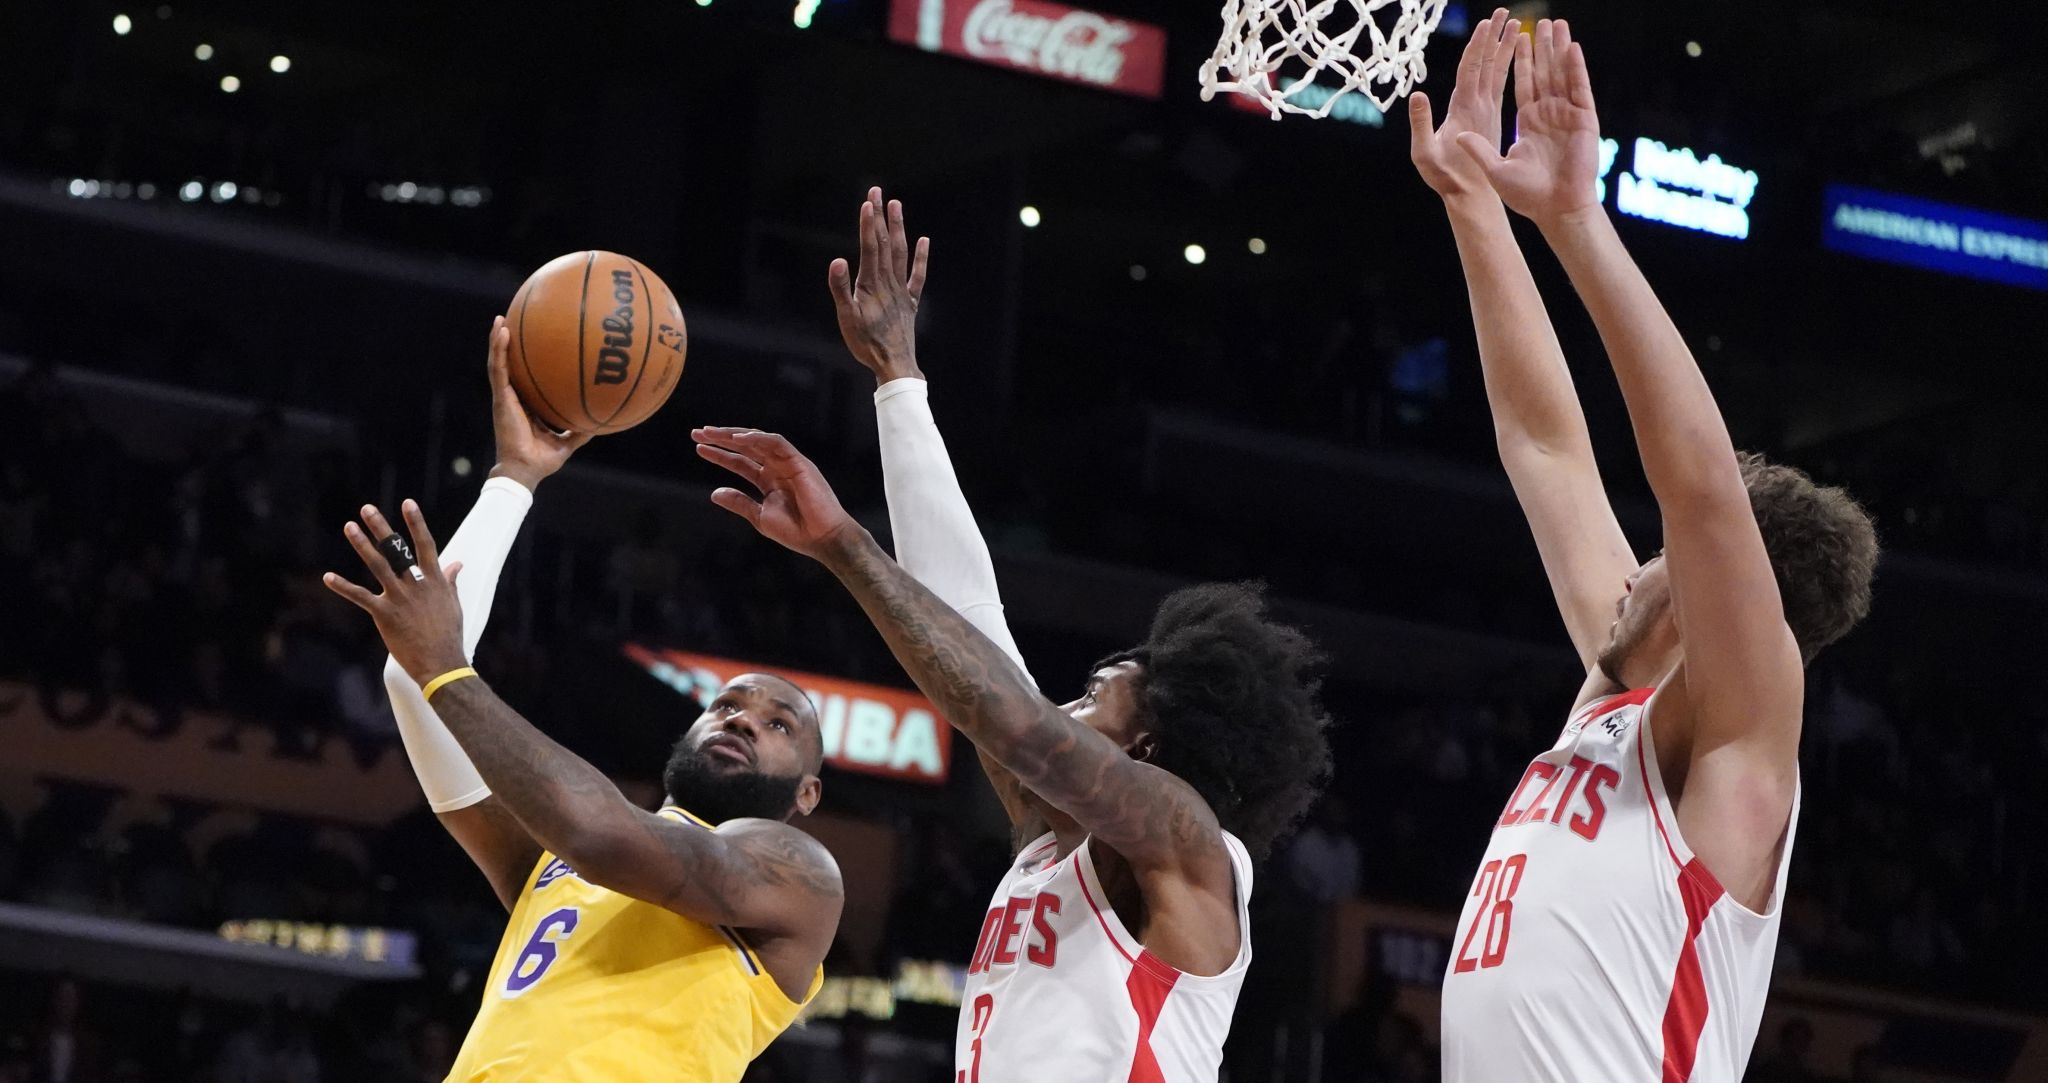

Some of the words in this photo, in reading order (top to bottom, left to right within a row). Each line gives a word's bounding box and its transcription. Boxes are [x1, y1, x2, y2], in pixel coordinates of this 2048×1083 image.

[1834, 203, 1960, 252] AMERICAN
[594, 269, 634, 386] Wilson
[503, 907, 578, 998] 6
[1453, 854, 1528, 975] 28
